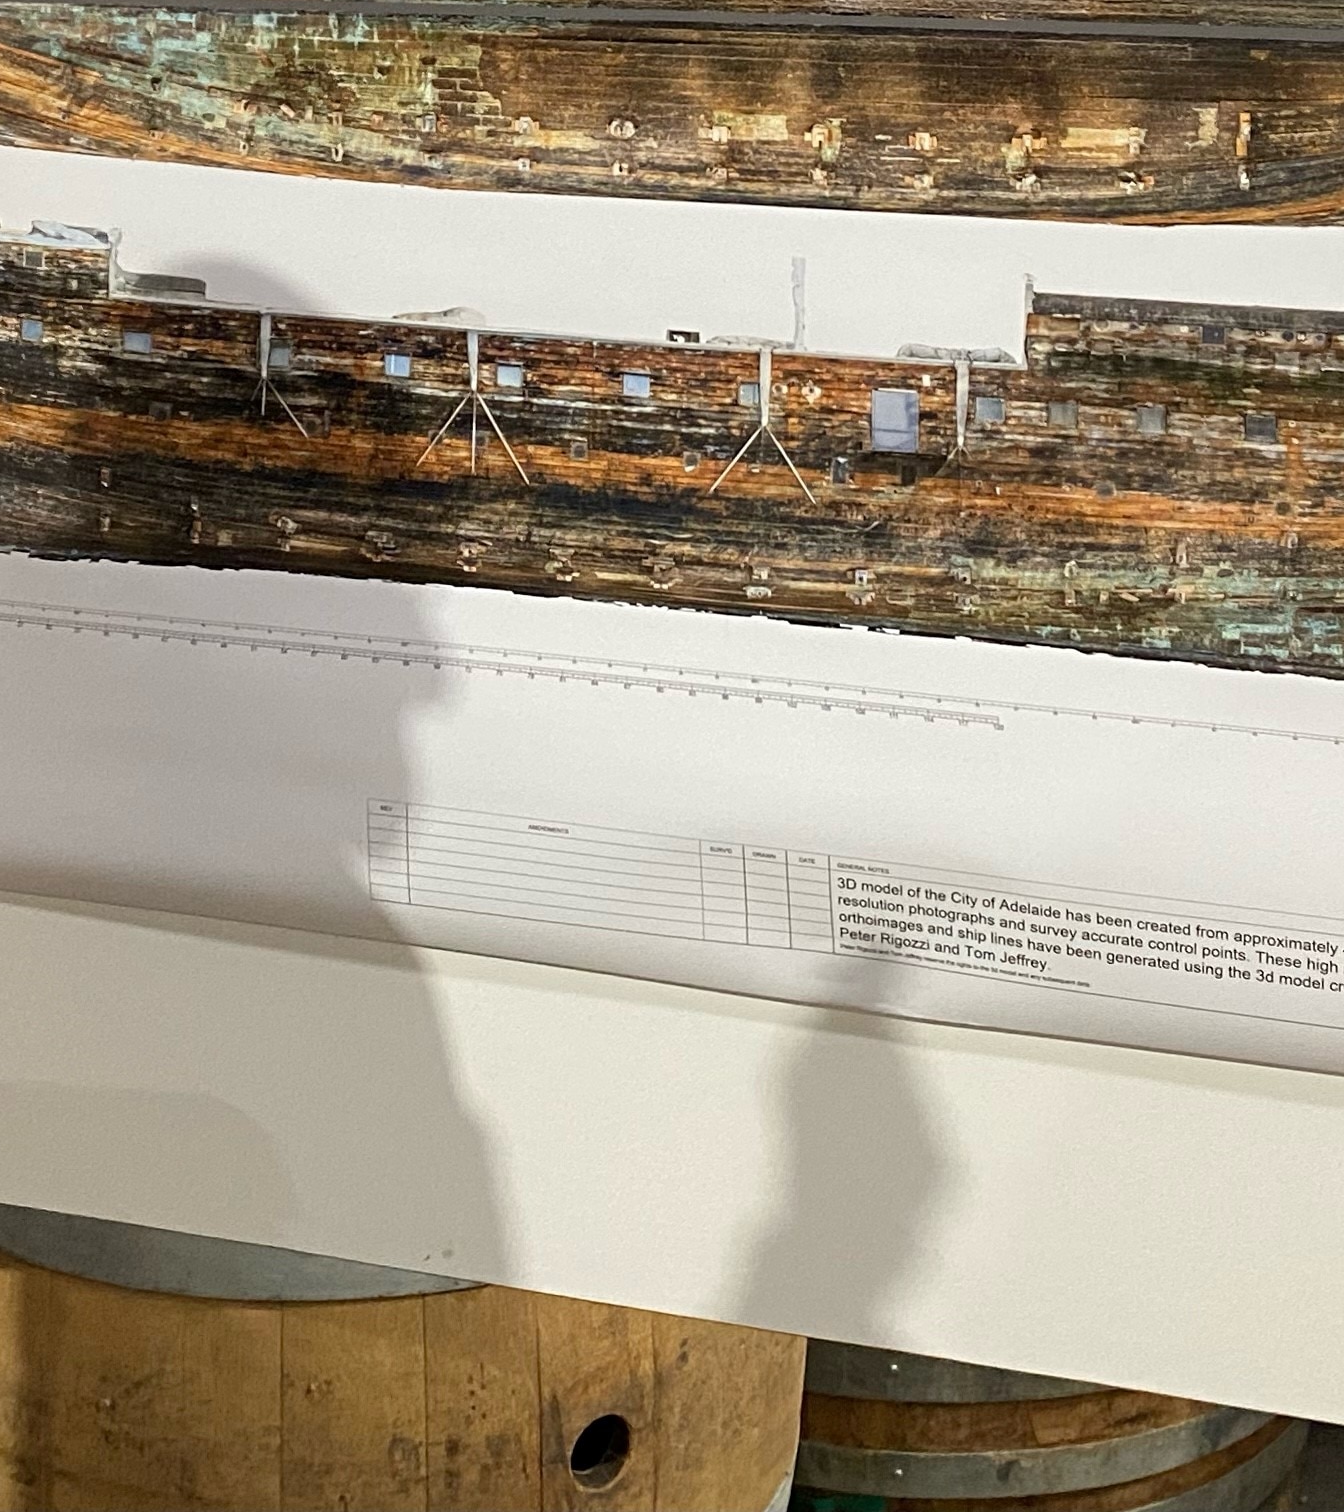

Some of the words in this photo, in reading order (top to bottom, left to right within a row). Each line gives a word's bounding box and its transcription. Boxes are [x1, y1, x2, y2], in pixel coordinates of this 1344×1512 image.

[837, 877, 857, 891] 3D
[861, 882, 903, 897] model
[907, 886, 922, 900] of
[924, 888, 947, 905] the
[950, 891, 978, 909] City
[981, 896, 996, 910] of
[998, 898, 1061, 919] Adelaide
[1065, 908, 1092, 924] has
[1096, 912, 1133, 931] been
[1136, 920, 1191, 936] created
[1195, 924, 1229, 941] from
[1233, 932, 1339, 958] approximately
[837, 896, 905, 915] resolution
[907, 903, 996, 926] photographs
[999, 918, 1026, 932] and
[1028, 923, 1078, 942] survey
[1080, 931, 1144, 948] accurate
[1147, 939, 1197, 956] control
[1254, 950, 1302, 969] These
[1305, 955, 1339, 975] high
[838, 912, 924, 933] orthoimages
[927, 924, 954, 938] and
[957, 927, 987, 945] ship
[990, 931, 1024, 949] lines
[1026, 936, 1062, 955] have
[1065, 943, 1102, 961] been
[1106, 952, 1180, 971] generated
[1184, 961, 1224, 979] using
[1227, 965, 1251, 980] the
[1254, 969, 1274, 983] 3d
[1278, 973, 1325, 990] model
[839, 927, 877, 943] Peter
[880, 932, 931, 951] Rigozzi
[934, 942, 960, 956] and
[963, 944, 996, 962] Tom
